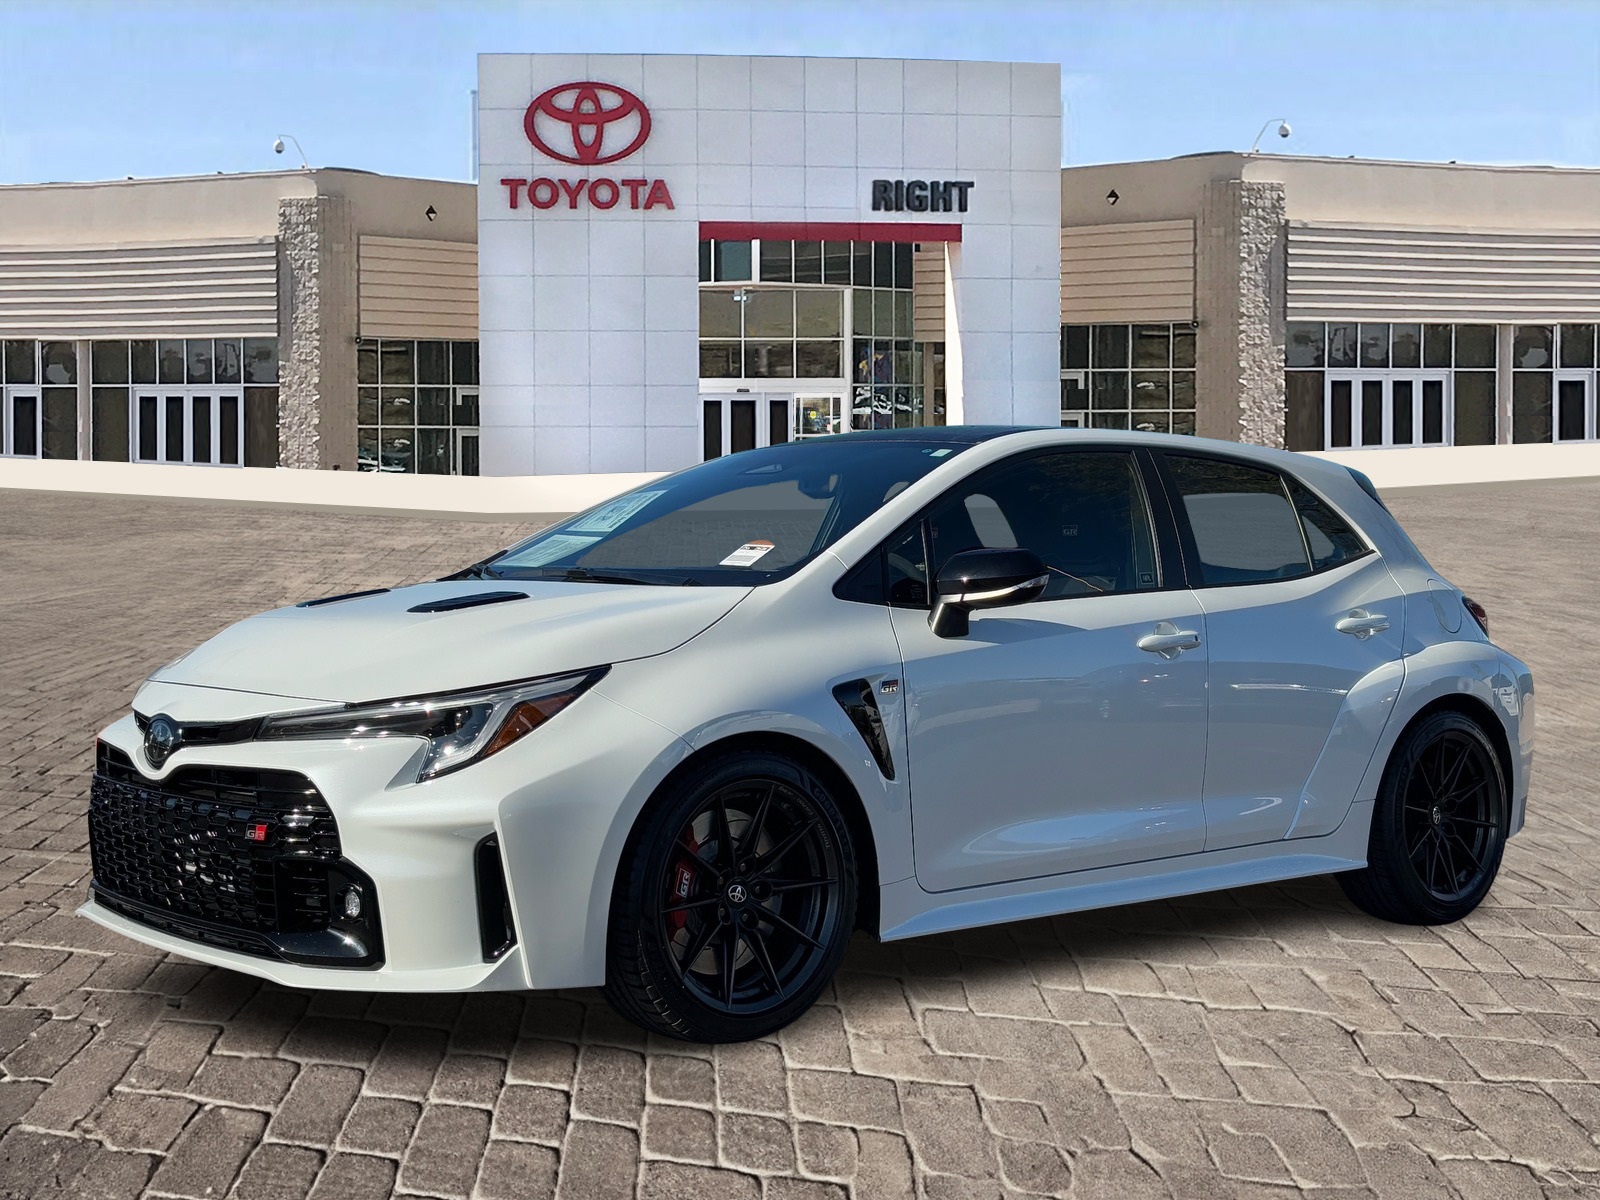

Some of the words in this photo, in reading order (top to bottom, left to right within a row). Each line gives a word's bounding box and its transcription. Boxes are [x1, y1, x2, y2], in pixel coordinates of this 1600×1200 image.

[500, 177, 675, 210] TOYOTA
[872, 179, 975, 212] RIGHT
[881, 685, 898, 694] GR
[247, 829, 265, 841] GR
[680, 870, 691, 899] GR
